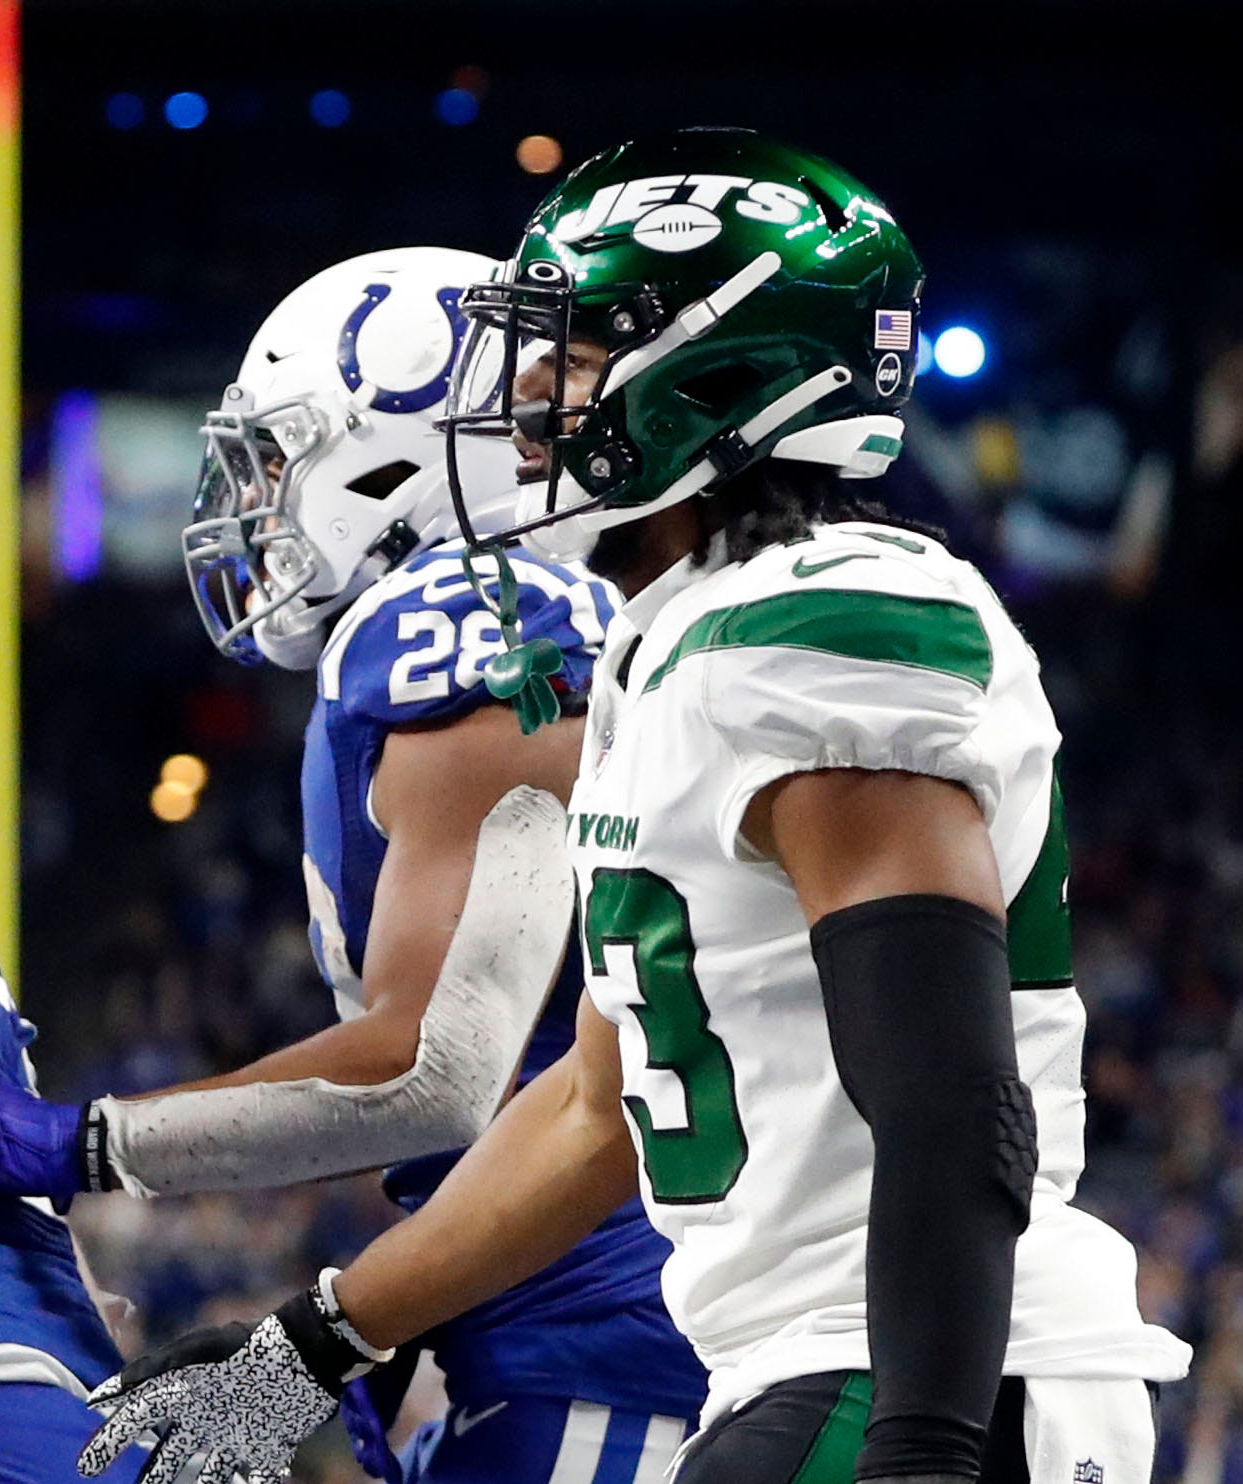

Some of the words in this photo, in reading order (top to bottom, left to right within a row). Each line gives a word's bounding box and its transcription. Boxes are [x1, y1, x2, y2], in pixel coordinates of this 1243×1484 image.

[553, 173, 810, 241] JETS
[388, 609, 524, 705] 28
[572, 865, 749, 1204] 3
